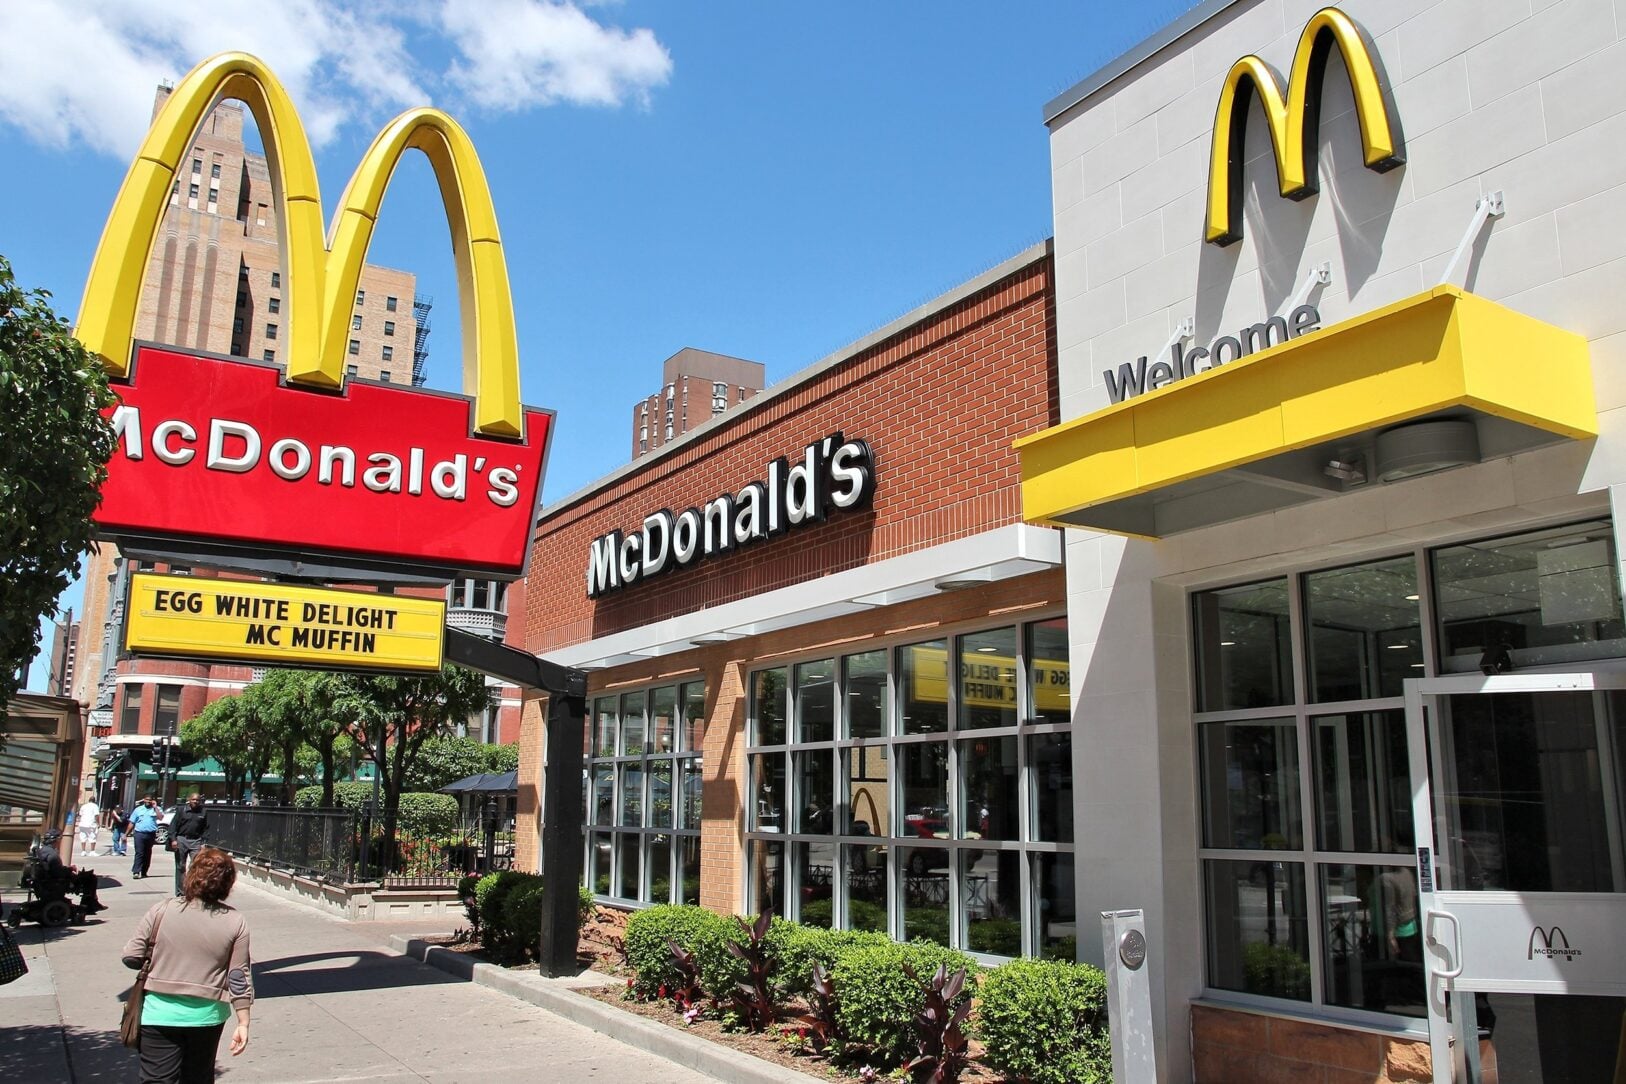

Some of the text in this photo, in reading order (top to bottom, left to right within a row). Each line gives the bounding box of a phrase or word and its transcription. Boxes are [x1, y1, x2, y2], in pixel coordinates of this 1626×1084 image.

[1103, 305, 1321, 405] Welcome
[587, 435, 872, 598] McDonald's
[154, 590, 397, 630] EGG WHITE DELIGHT
[246, 623, 376, 653] MC MUFFIN
